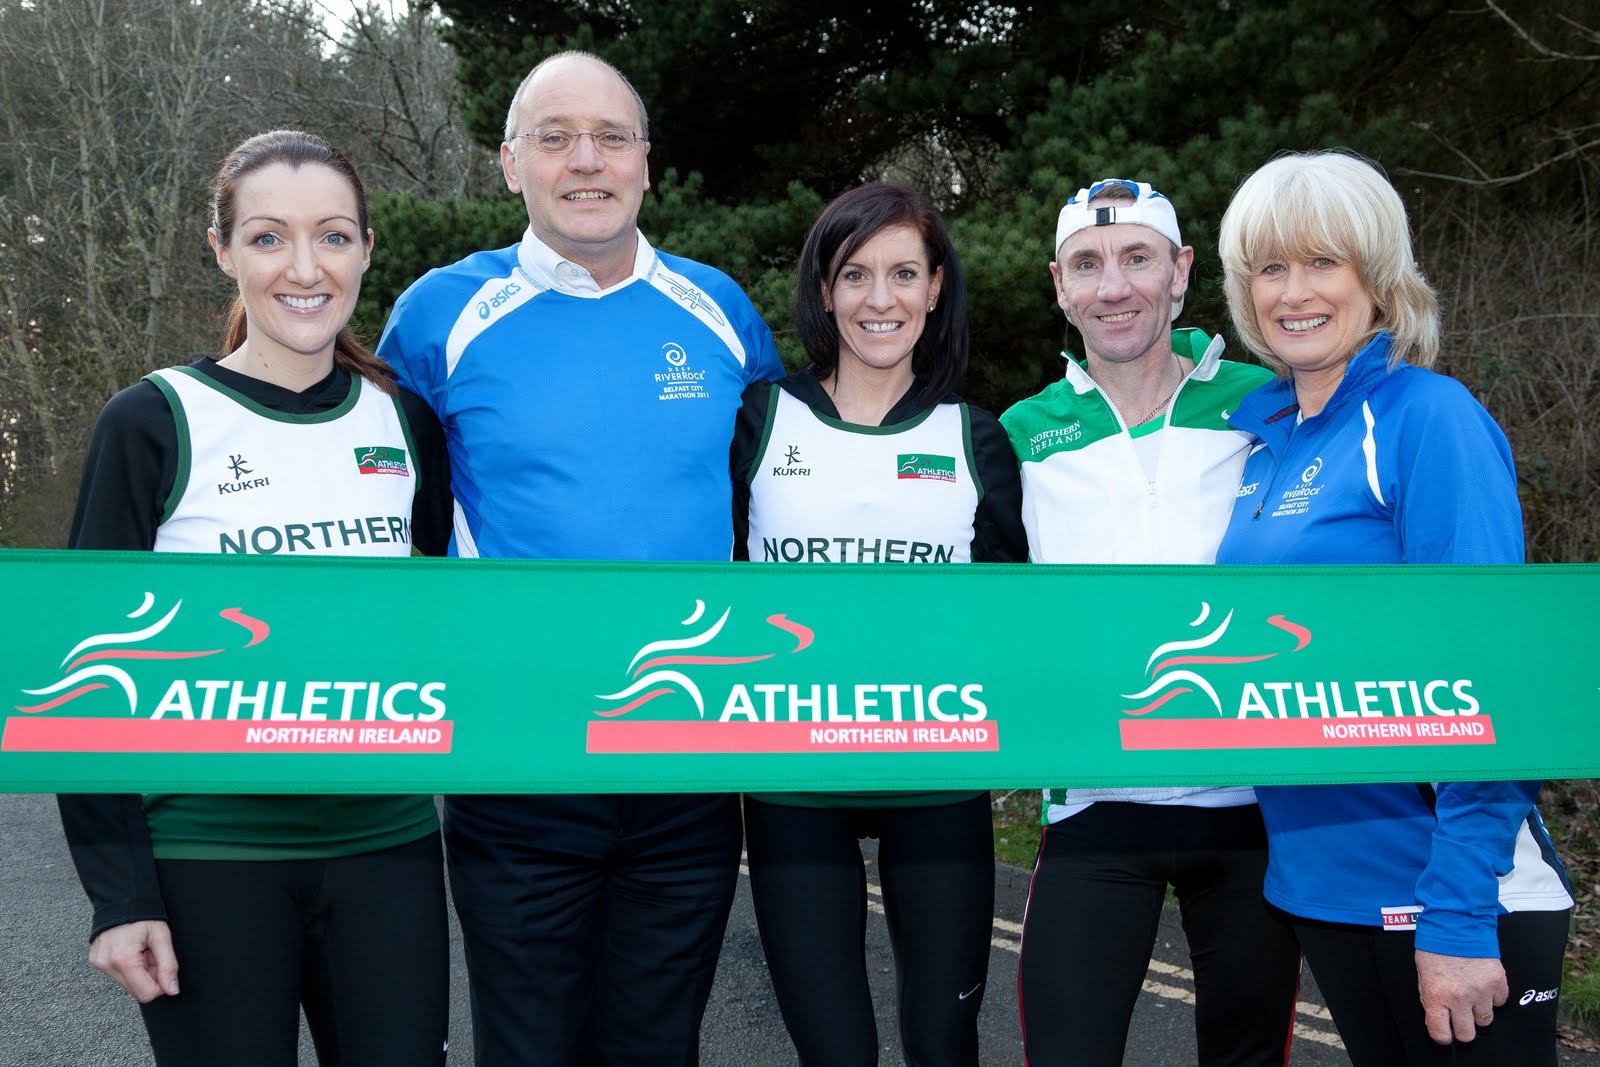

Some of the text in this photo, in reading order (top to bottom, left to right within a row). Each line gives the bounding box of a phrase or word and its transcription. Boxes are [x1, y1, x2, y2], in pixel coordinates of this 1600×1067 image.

[489, 282, 522, 308] asics
[658, 392, 696, 400] MARATHON
[663, 385, 690, 393] BELFAST
[1029, 420, 1080, 446] NORTHERN
[1030, 431, 1082, 456] IRELAND
[773, 467, 811, 477] KUKRI
[917, 467, 956, 478] ATHLETICS
[217, 476, 271, 495] KUKRI
[1271, 508, 1297, 517] MARATHON
[219, 516, 411, 555] NORTHERN
[762, 537, 955, 563] NORTHERN
[150, 680, 447, 722] ATHLETICS
[719, 684, 988, 723] ATHLETICS
[1237, 679, 1480, 720] ATHLETICS
[245, 727, 442, 745] NORTHERN IRELAND
[810, 727, 988, 744] NORTHERN IRELAND
[1322, 721, 1485, 739] NORTHERN IRELAND
[1382, 914, 1408, 924] TEAM
